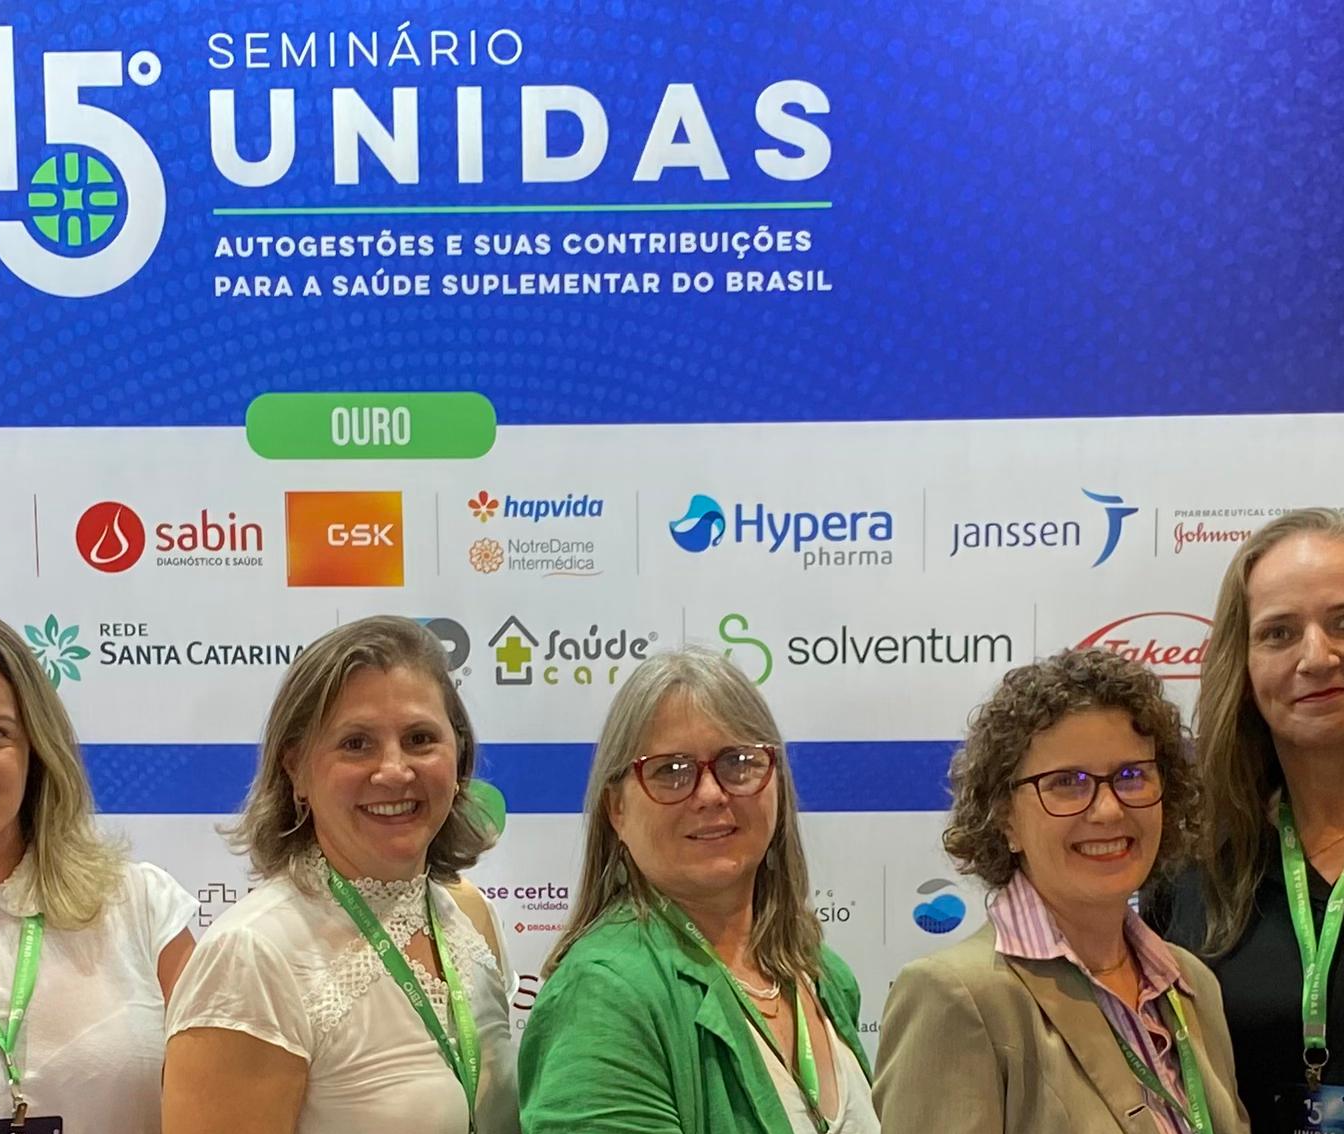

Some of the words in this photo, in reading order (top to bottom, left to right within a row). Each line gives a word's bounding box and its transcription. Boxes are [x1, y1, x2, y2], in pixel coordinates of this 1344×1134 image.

[208, 22, 523, 69] SEMINÁRIO
[210, 80, 832, 188] UNIDAS
[215, 229, 435, 258] AUTOGESTÕES
[446, 235, 463, 256] E
[475, 234, 552, 256] SUAS
[562, 224, 812, 260] CONTRIBUIÇÕES
[214, 275, 293, 298] PARA
[302, 275, 322, 297] A
[332, 267, 431, 297] SAÚDE
[442, 271, 661, 296] SUPLEMENTAR
[672, 270, 715, 294] DO
[726, 270, 833, 293] BRASIL
[331, 406, 411, 446] OURO
[503, 493, 604, 523] hapvida
[1174, 508, 1265, 518] PHARMACEUTICAL
[155, 509, 264, 553] sabin
[327, 523, 394, 546] GSK
[735, 503, 893, 554] Hypera
[950, 520, 1081, 557] janssen
[508, 538, 594, 554] NotreDame
[803, 546, 893, 571] pharma
[156, 556, 223, 567] DIAGNÓSTICO
[225, 557, 231, 566] E
[232, 555, 264, 567] SAÚDE
[508, 556, 595, 571] Intermédica
[99, 622, 149, 637] REDE
[544, 623, 649, 661] Saúde
[99, 640, 183, 666] SANTA
[787, 625, 1013, 665] solventum
[1103, 638, 1212, 665] Taked
[543, 665, 620, 685] car
[513, 882, 569, 900] certa
[526, 924, 567, 932] DROGAS
[1303, 1098, 1323, 1125] 15
